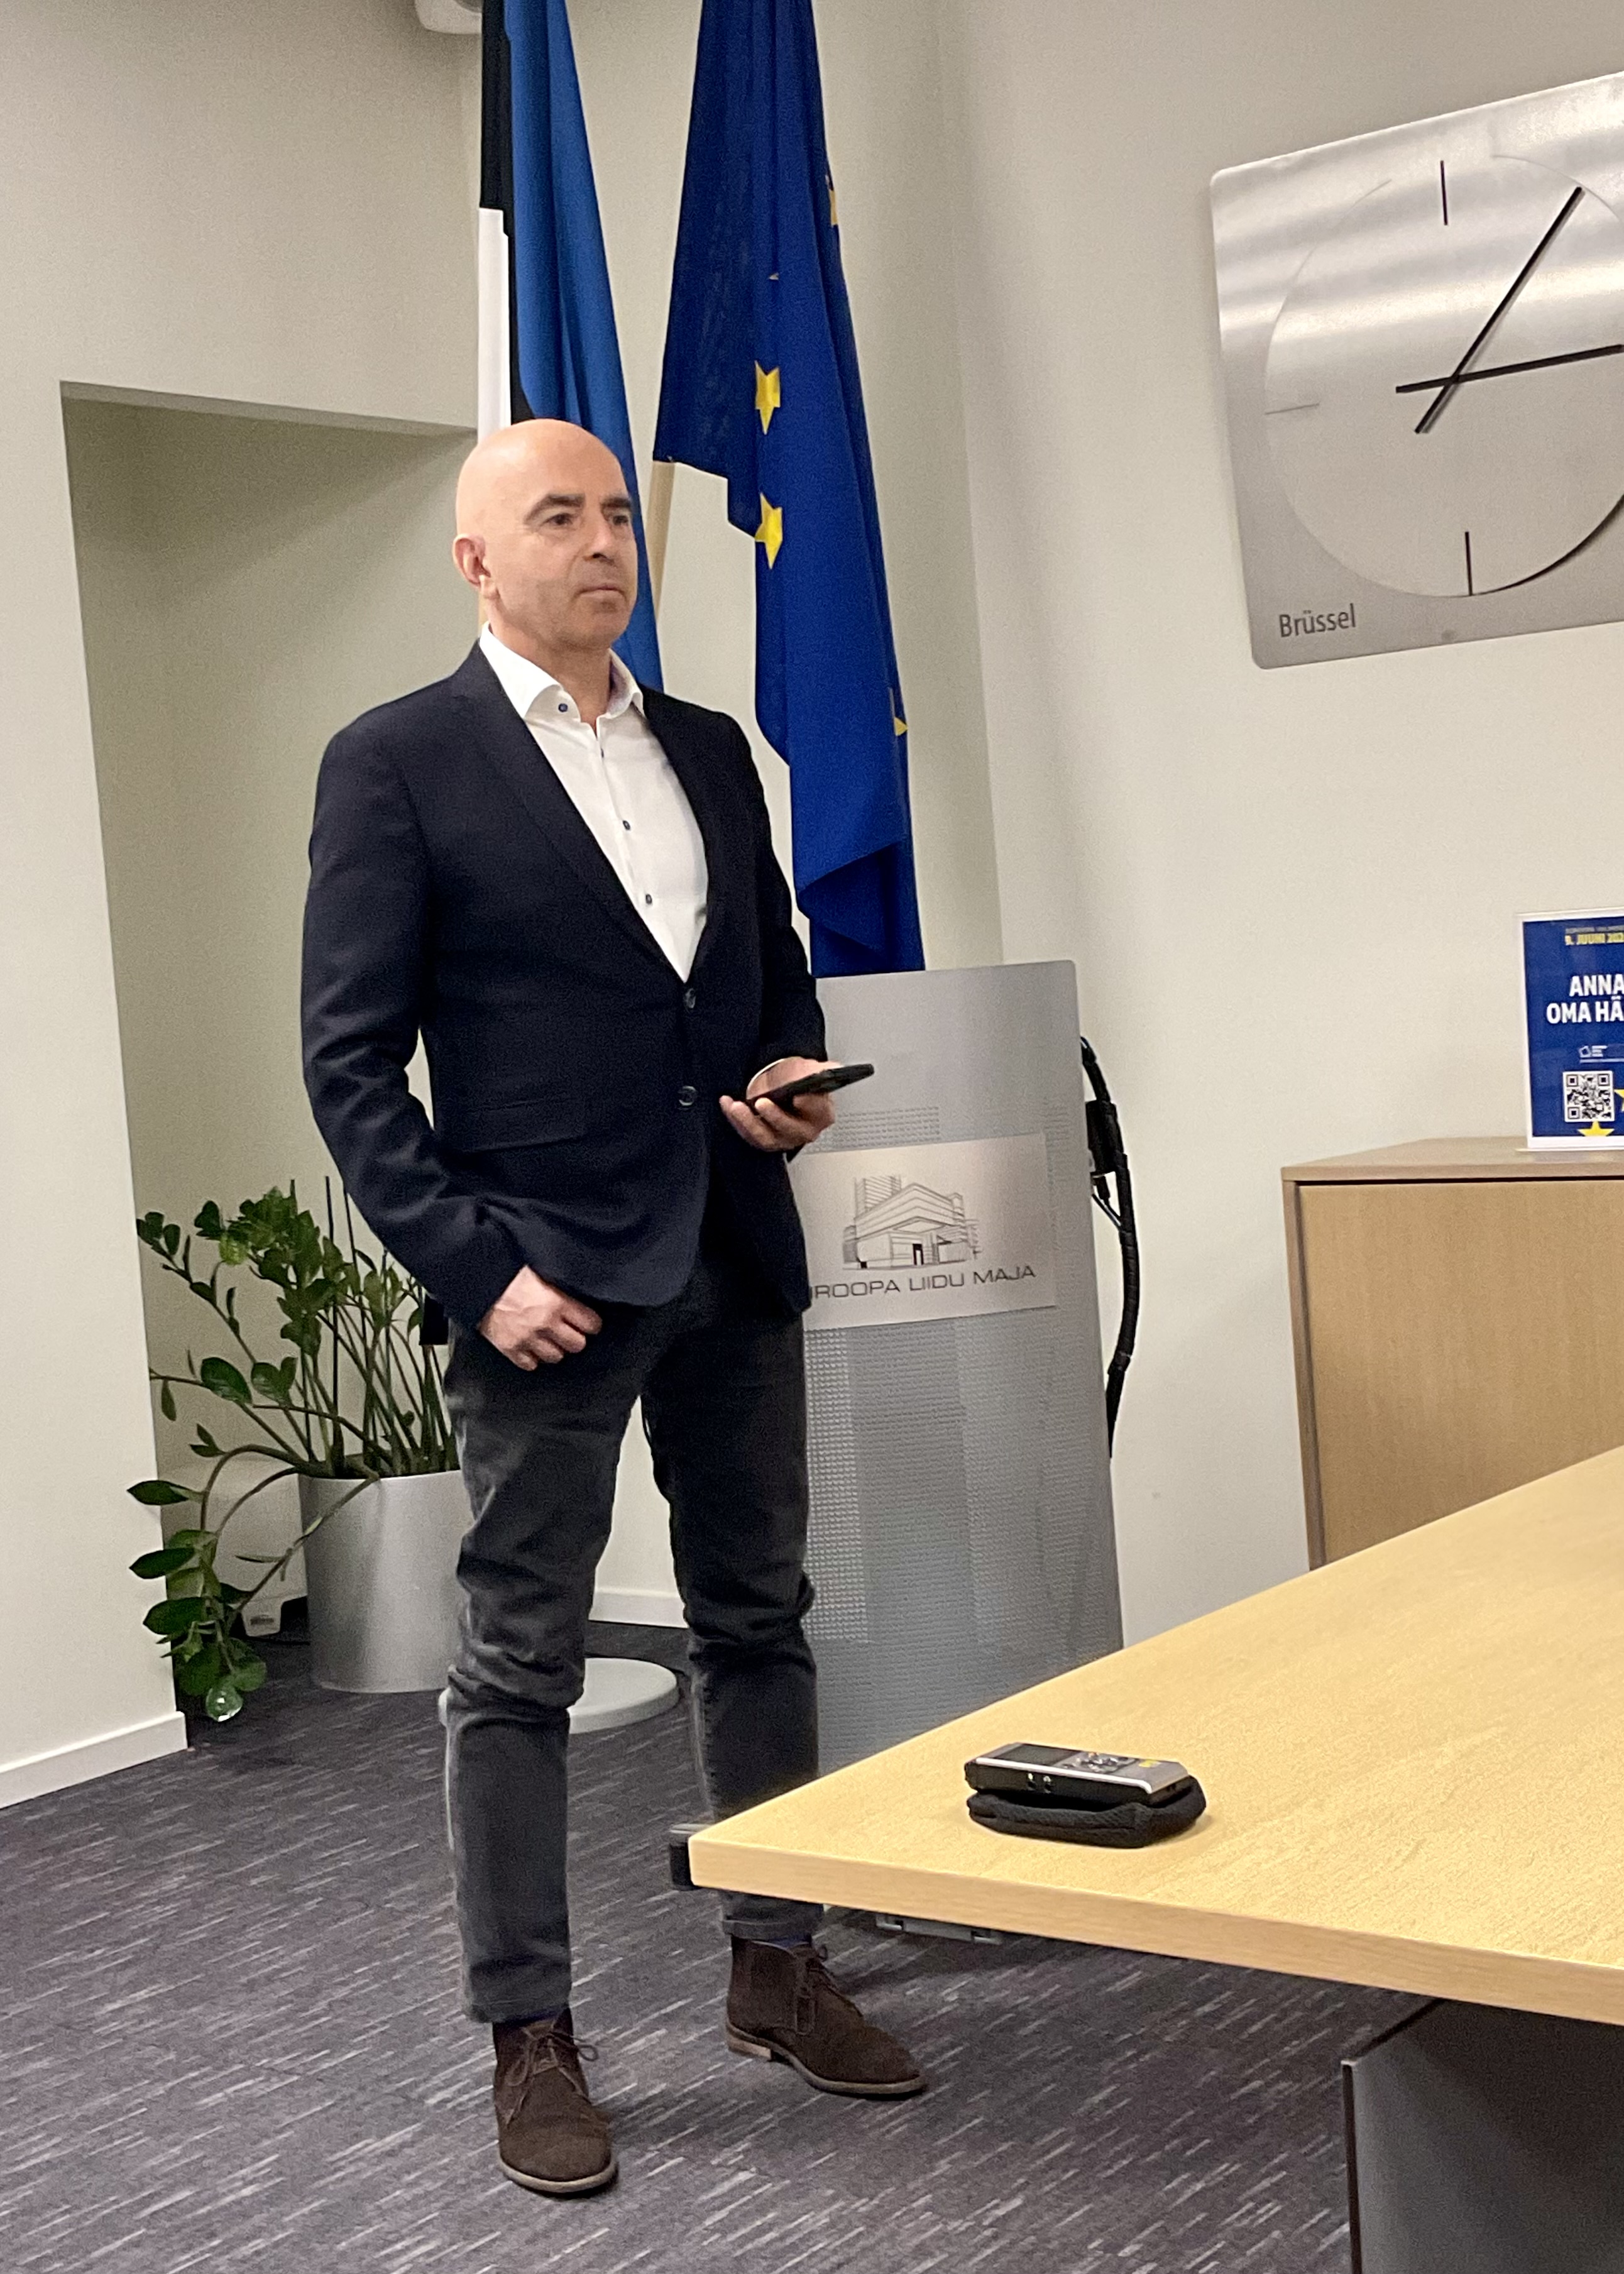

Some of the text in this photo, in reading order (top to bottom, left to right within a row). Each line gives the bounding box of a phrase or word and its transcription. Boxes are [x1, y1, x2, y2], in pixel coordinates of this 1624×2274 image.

[1279, 603, 1356, 638] Brüssel
[1569, 974, 1624, 997] ANNA
[1546, 1001, 1591, 1024] OMA
[809, 1280, 901, 1299] ROOPA
[973, 1265, 1036, 1284] MAJA
